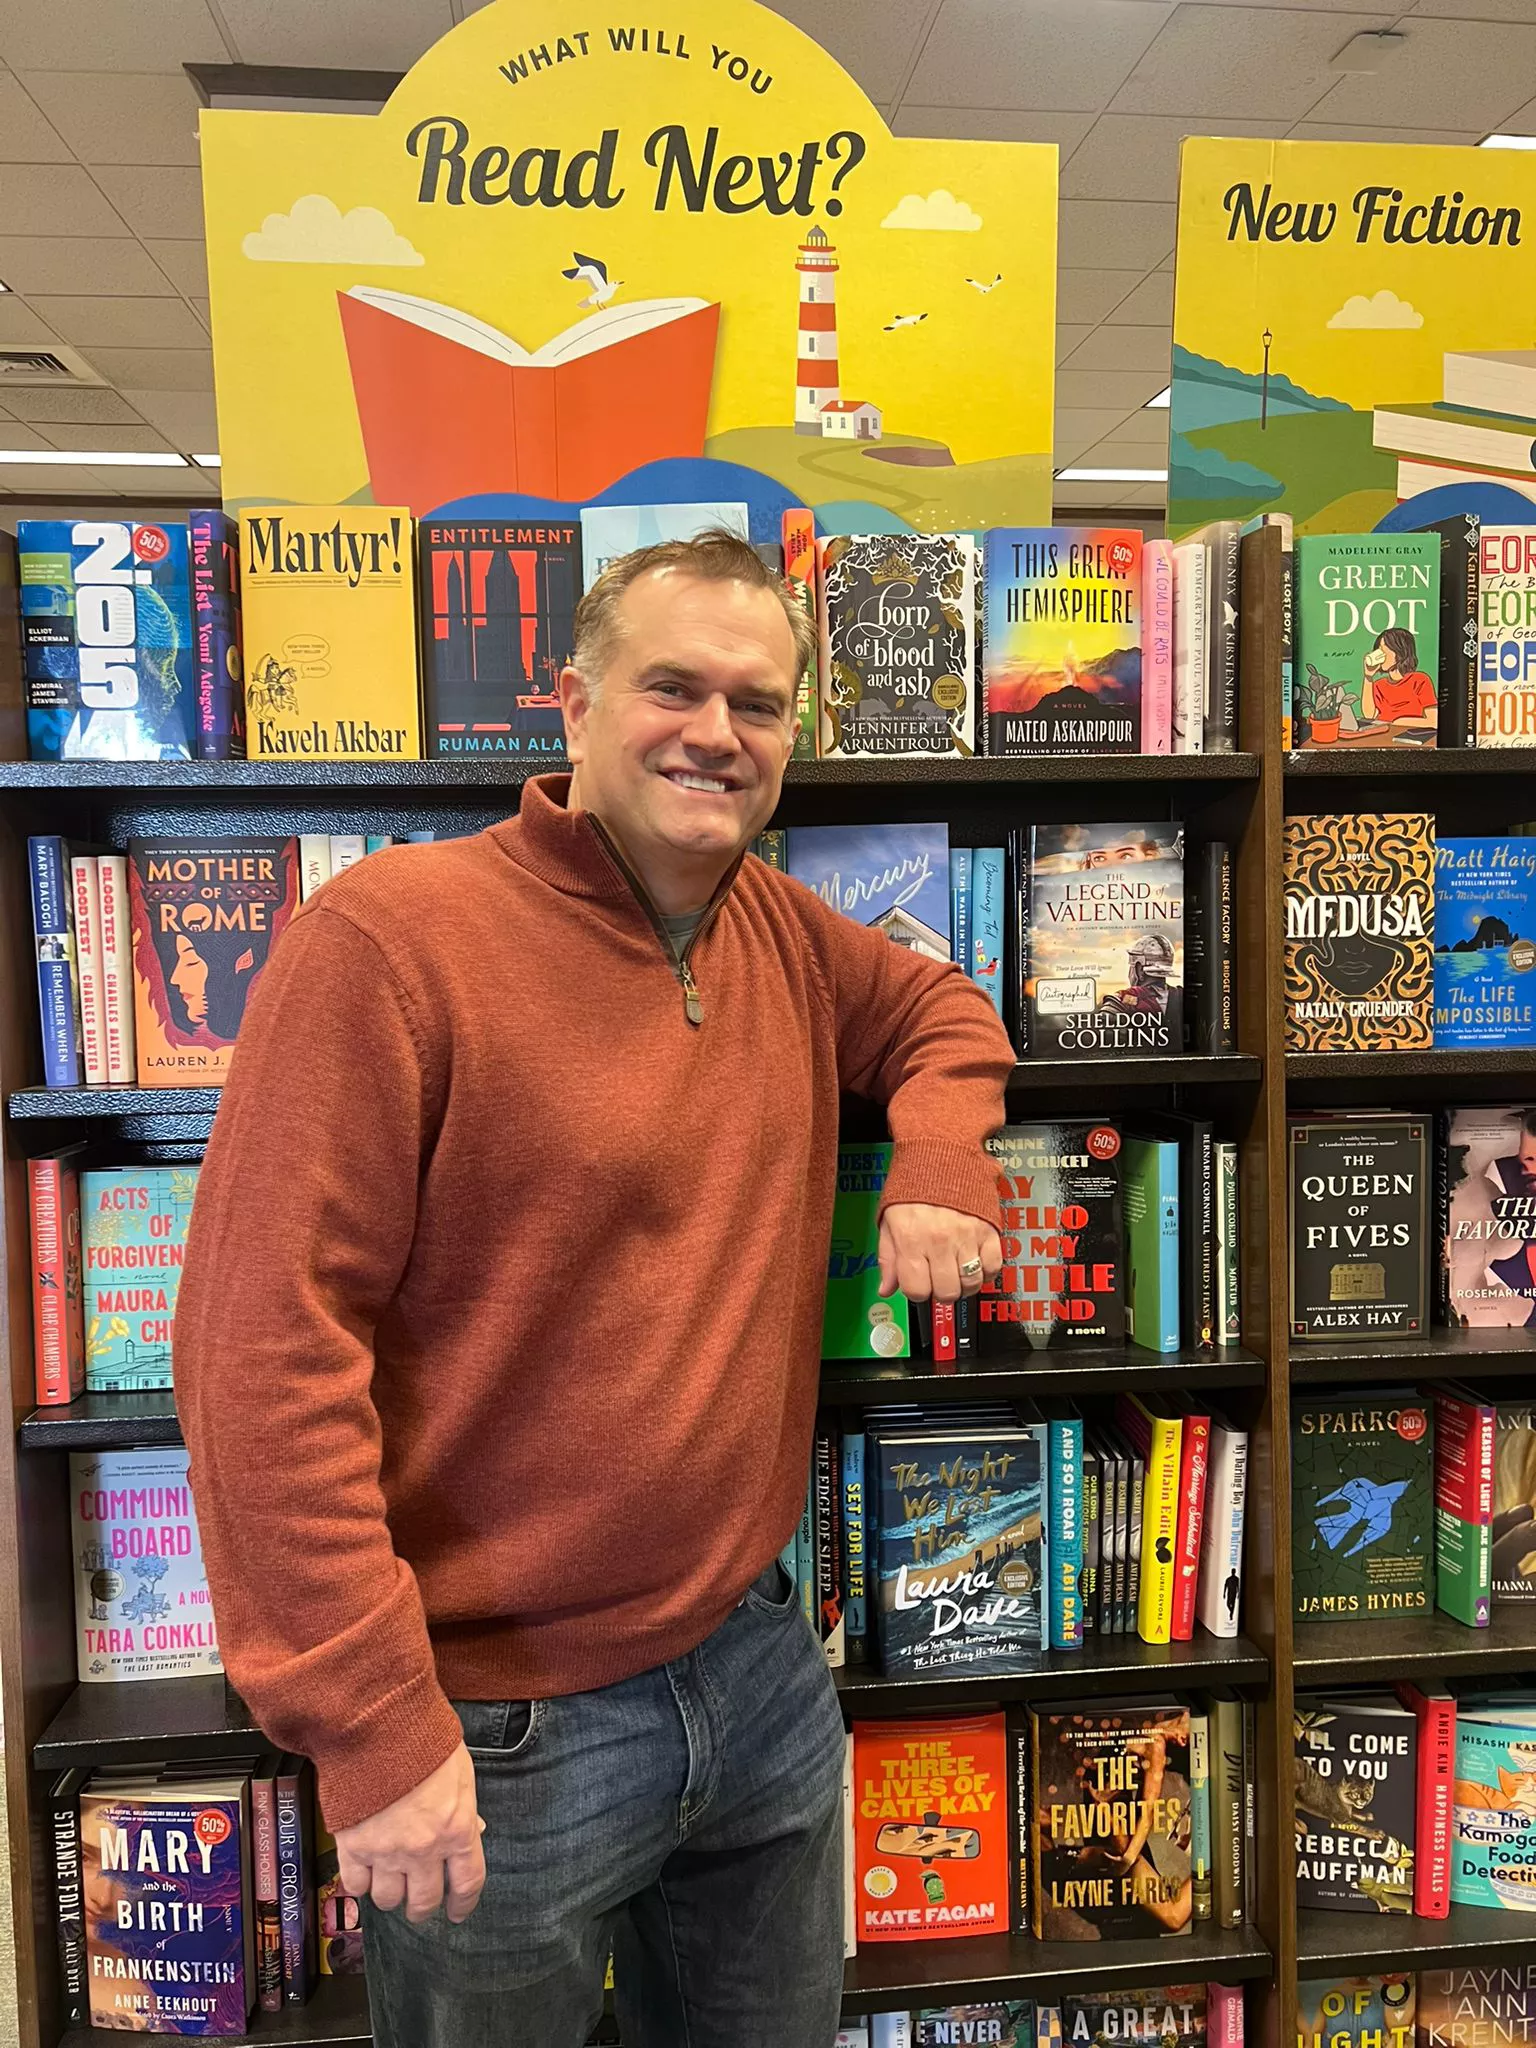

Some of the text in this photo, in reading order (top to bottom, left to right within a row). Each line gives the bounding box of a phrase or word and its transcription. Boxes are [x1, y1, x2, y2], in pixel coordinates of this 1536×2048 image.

[498, 28, 773, 94] WHAT WILL YOU
[406, 116, 866, 216] Read Next?
[1224, 183, 1521, 246] New Fiction
[430, 528, 574, 544] ENTITLEMENT
[247, 517, 402, 587] Martyr!
[1012, 544, 1058, 579] THIS
[1328, 546, 1424, 556] MADELEINE GRAY
[1318, 565, 1431, 590] GREEN
[1467, 552, 1477, 615] Kantika
[879, 582, 930, 629] born
[1007, 588, 1134, 624] HEMISPHERE
[1194, 553, 1202, 640] BAUMGARTNER
[193, 523, 216, 732] The List Yomi Adegoke
[1323, 599, 1428, 636] DOT
[874, 638, 934, 667] blood
[867, 668, 931, 698] and ash
[1225, 632, 1236, 727] KIRSTEN BAKIS
[258, 721, 407, 754] Kaveh Akbar
[851, 722, 929, 737] JENNIFER
[1006, 720, 1133, 743] MATEO ASKARIPOUR
[439, 738, 520, 751] RUMAAN
[840, 738, 952, 751] ARMENTROUT
[148, 859, 276, 881] MOTHER
[1435, 847, 1484, 869] Matt
[37, 845, 51, 929] MARY BALOGH
[810, 853, 934, 913] Mercury
[1105, 873, 1124, 881] THE
[201, 887, 221, 899] OF
[1066, 883, 1151, 901] LEGEND
[1456, 890, 1492, 904] Midnight
[76, 868, 90, 954] BLOOD TEST
[103, 867, 115, 953] BLOOD TEST
[161, 903, 266, 932] ROME
[1045, 901, 1182, 922] VALENTINE
[1222, 902, 1230, 946] FACTORY
[1286, 893, 1425, 939] MEDUSA
[1040, 982, 1093, 1000] Autographed
[1481, 986, 1516, 1002] LIFE
[53, 966, 68, 1063] REMEMBER WHEN
[1066, 1012, 1162, 1029] SHELDON
[1295, 1001, 1414, 1018] NATALY GRUENDER
[1058, 1027, 1169, 1049] COLLINS
[147, 1057, 207, 1066] LAUREN
[1027, 1155, 1089, 1169] CRUCET
[1203, 1133, 1211, 1179] BERNARD
[1343, 1155, 1375, 1166] THE
[100, 1187, 149, 1210] ACTS
[1302, 1174, 1414, 1201] QUEEN
[149, 1214, 174, 1237] OF
[1348, 1206, 1369, 1217] OF
[1031, 1236, 1079, 1259] MY
[1306, 1224, 1411, 1249] FIVES
[87, 1244, 183, 1269] FORGIVEN
[35, 1168, 61, 1381] SHY CREATURES CHAMBERS
[1228, 1268, 1238, 1306] MAKTUB
[97, 1289, 168, 1313] MAURA
[1457, 1288, 1520, 1298] ROSEMARY
[980, 1300, 1096, 1322] FRIEND
[1312, 1312, 1403, 1327] ALEX HAY
[890, 1450, 1016, 1494] The Night
[1161, 1453, 1174, 1501] Villain
[1188, 1452, 1206, 1504] Marriage
[1480, 1427, 1492, 1512] SEASON LIGHT
[904, 1485, 1001, 1526] We Lost
[1062, 1427, 1075, 1591] AND SO ROAR ABI
[112, 1525, 191, 1559] BOARD
[846, 1483, 863, 1598] SET FOR LIFE
[913, 1525, 975, 1560] Him
[820, 1544, 831, 1592] SLEEP
[895, 1564, 994, 1611] Laura
[930, 1597, 1030, 1636] Dave
[1299, 1592, 1426, 1613] JAMES HYNES
[84, 1628, 134, 1654] TARA
[904, 1742, 951, 1758] THE
[1350, 1734, 1408, 1755] COME
[1462, 1735, 1510, 1749] HISASHI
[881, 1756, 975, 1778] THREE
[1094, 1756, 1138, 1791] THE
[1303, 1756, 1388, 1780] TO YOU
[865, 1773, 990, 1799] LIVES OF
[860, 1792, 996, 1818] CATE KAY
[1432, 1713, 1449, 1893] ANGIE KIM HAPPINESS FALLS
[1051, 1798, 1181, 1839] FAVORITES
[1498, 1812, 1531, 1829] The
[99, 1828, 214, 1874] MARY
[279, 1799, 298, 1921] HOUR CROWS
[1232, 1837, 1240, 1888] GOODWIN
[54, 1811, 80, 1922] STRANGE FOLK
[259, 1853, 271, 1895] HOUSES
[1297, 1861, 1406, 1884] AUFFMAN
[142, 1882, 160, 1891] and
[1052, 1879, 1113, 1908] LAYNE
[117, 1901, 203, 1932] BIRTH
[865, 1903, 995, 1925] KATE FAGAN
[93, 1956, 235, 1984] FRANKENSTEIN
[115, 1994, 217, 2012] ANNE EEKHOUT
[1323, 1991, 1372, 2017] OF
[1455, 1992, 1526, 2020] ANN
[935, 2019, 1001, 2044] NEVER
[1072, 2004, 1194, 2041] A GREAT
[1227, 1998, 1236, 2044] GRIMALDI
